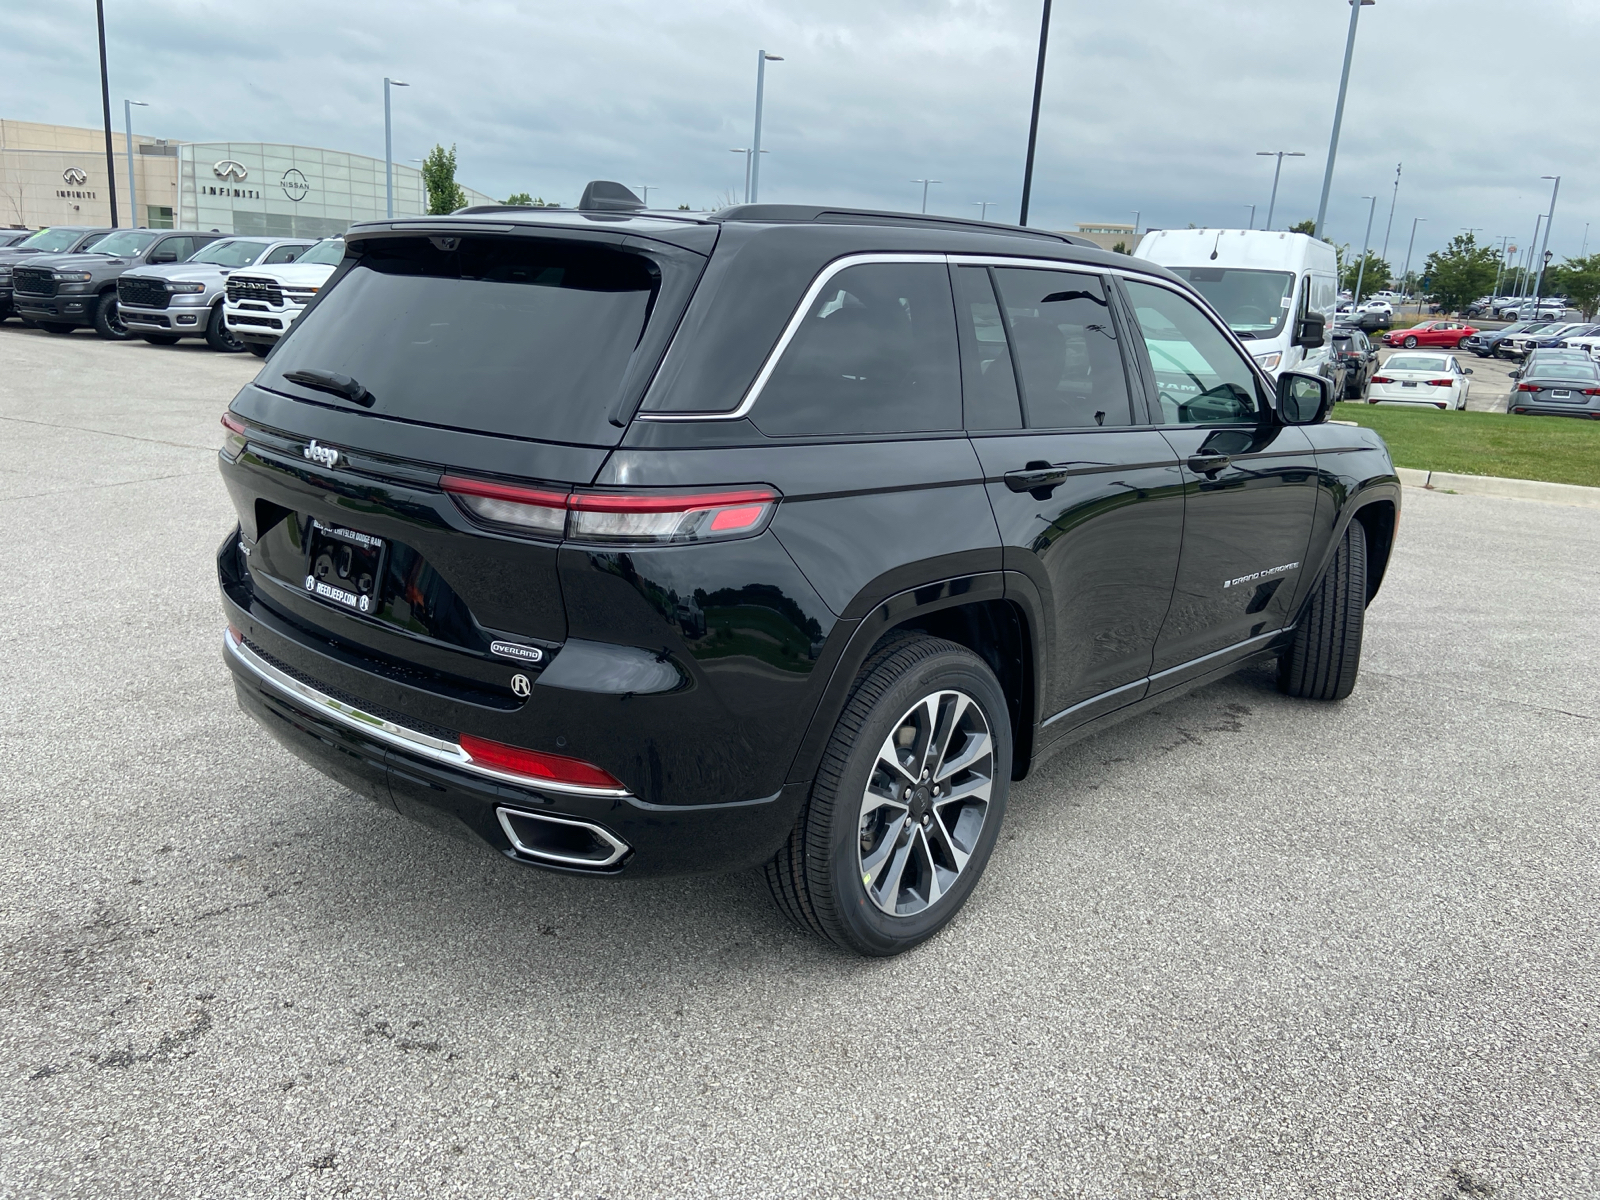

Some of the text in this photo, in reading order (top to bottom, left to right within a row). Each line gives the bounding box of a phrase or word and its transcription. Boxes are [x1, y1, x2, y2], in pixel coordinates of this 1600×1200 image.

[202, 186, 260, 199] INFINITI
[280, 181, 310, 190] NISSAN
[56, 190, 96, 199] INFINITI
[236, 281, 265, 290] RAM
[304, 439, 339, 469] Jeep
[355, 533, 371, 544] DODGE
[370, 536, 382, 547] RAM
[1231, 561, 1300, 586] GRAND CHEROKEE
[316, 582, 358, 607] REEDJEEP.COM
[492, 644, 539, 658] OVERLAND
